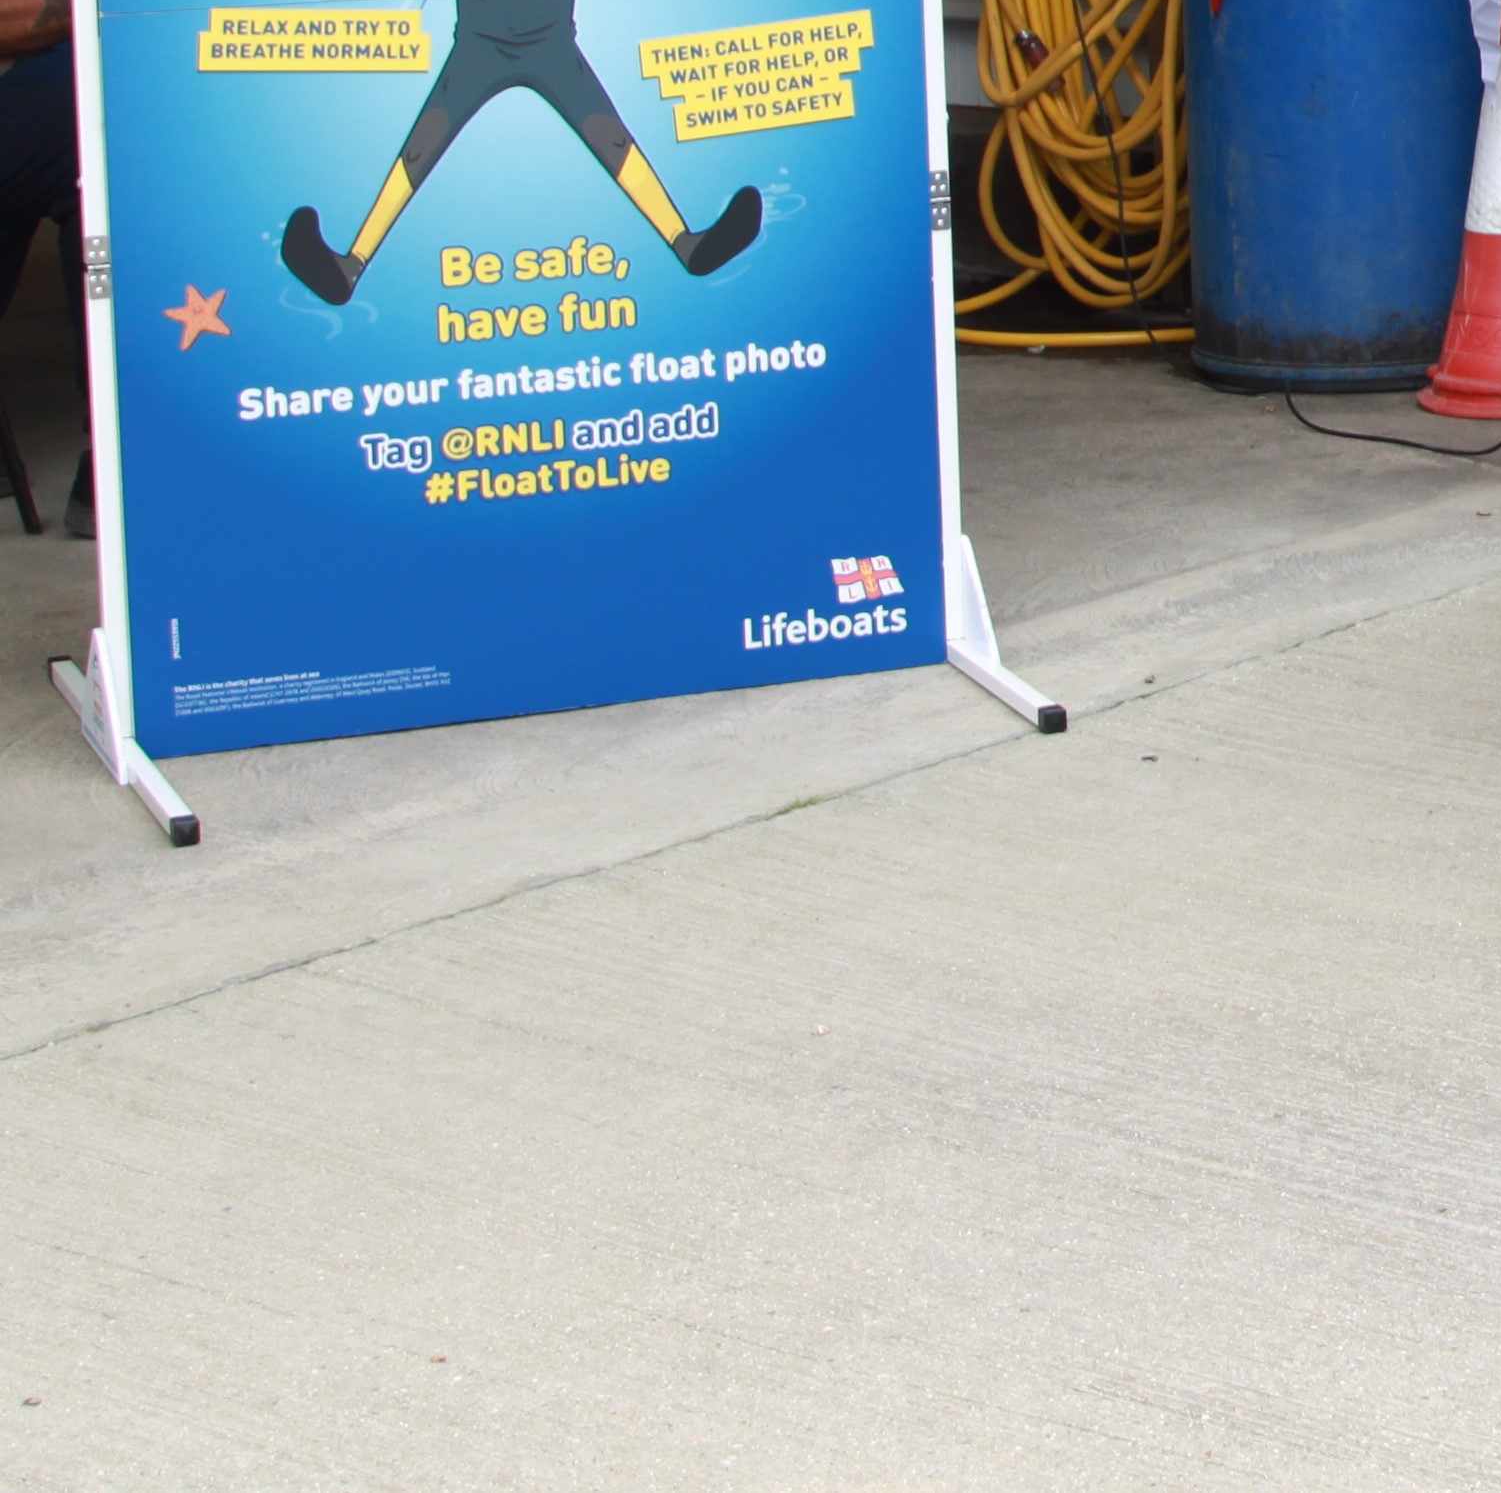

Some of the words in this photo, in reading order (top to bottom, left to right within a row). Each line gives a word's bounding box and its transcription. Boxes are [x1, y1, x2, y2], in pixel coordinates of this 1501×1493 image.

[222, 19, 288, 35] RELAX
[294, 19, 336, 35] AND
[343, 20, 381, 36] TRY
[386, 20, 410, 36] TO
[652, 44, 710, 65] THEN:
[715, 36, 763, 57] CALL
[768, 30, 804, 48] FOR
[810, 22, 863, 44] HELP,
[211, 43, 305, 59] BREATHE
[312, 43, 421, 59] NORMALLY
[670, 65, 718, 85] WAIT
[724, 58, 761, 77] FOR
[767, 51, 819, 71] HELP,
[824, 46, 849, 63] OR
[686, 107, 738, 128] SWIM
[744, 103, 767, 119] TO
[772, 92, 843, 116] SAFETY
[711, 85, 728, 102] IF
[734, 79, 770, 97] YOU
[776, 74, 813, 94] CAN
[441, 247, 502, 287] Be
[514, 237, 630, 284] safe,
[438, 303, 547, 343] have
[558, 292, 636, 333] fun
[239, 386, 353, 420] Share
[363, 377, 449, 415] your
[457, 356, 622, 400] fantastic
[629, 348, 716, 384] float
[725, 339, 827, 385] photo
[360, 433, 432, 474] Tag
[441, 418, 565, 461] @RNLI
[571, 409, 645, 450] and
[648, 401, 719, 443] add
[425, 453, 670, 504] #FloatToLive
[744, 604, 908, 650] Lifeboats
